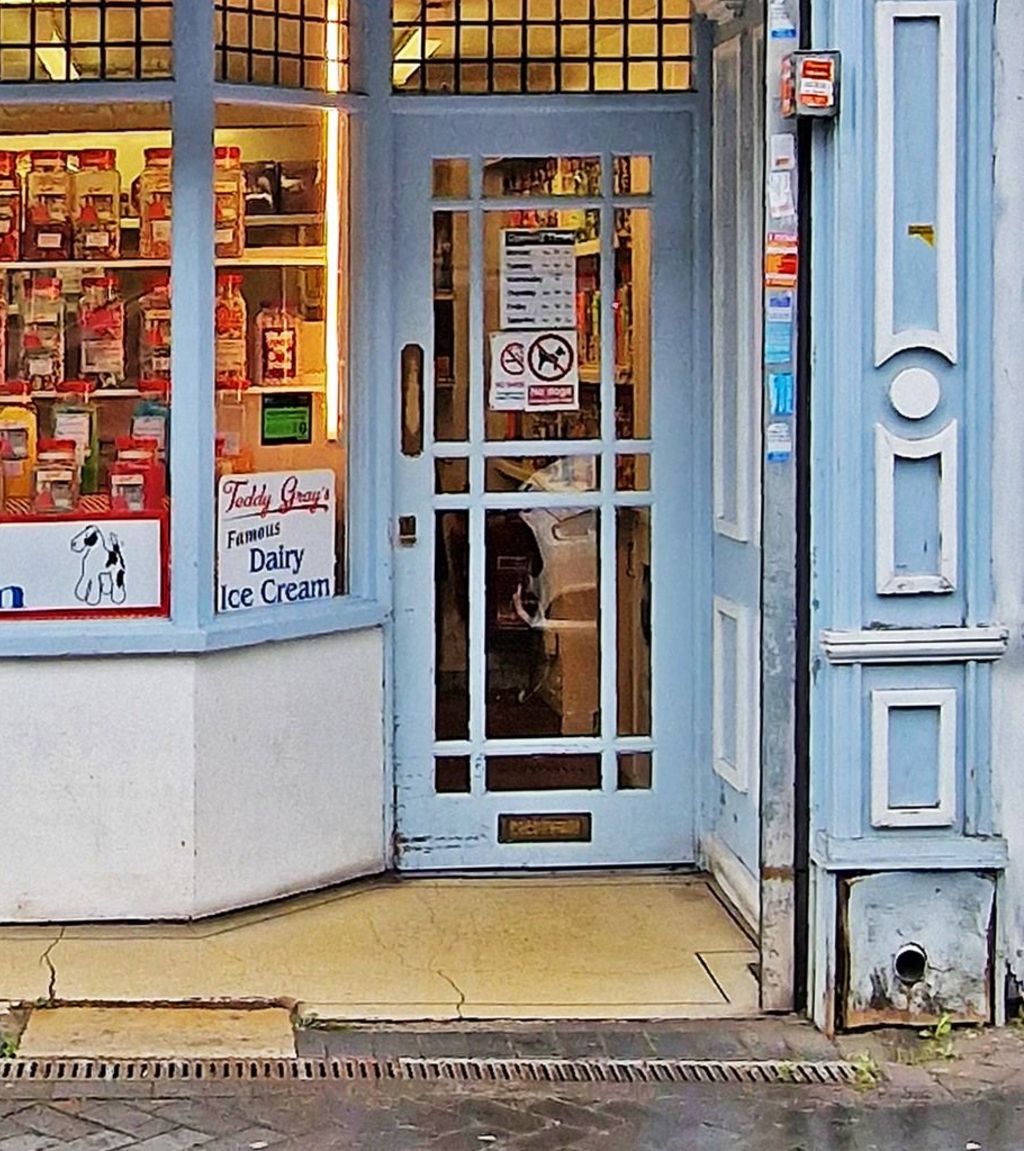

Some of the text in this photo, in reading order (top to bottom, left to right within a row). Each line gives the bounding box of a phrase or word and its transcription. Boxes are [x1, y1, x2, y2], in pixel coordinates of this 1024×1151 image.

[223, 475, 330, 518] Teddy Gray's
[227, 522, 281, 549] Famous
[250, 544, 305, 574] Dairy
[221, 577, 331, 610] Ice Cream
